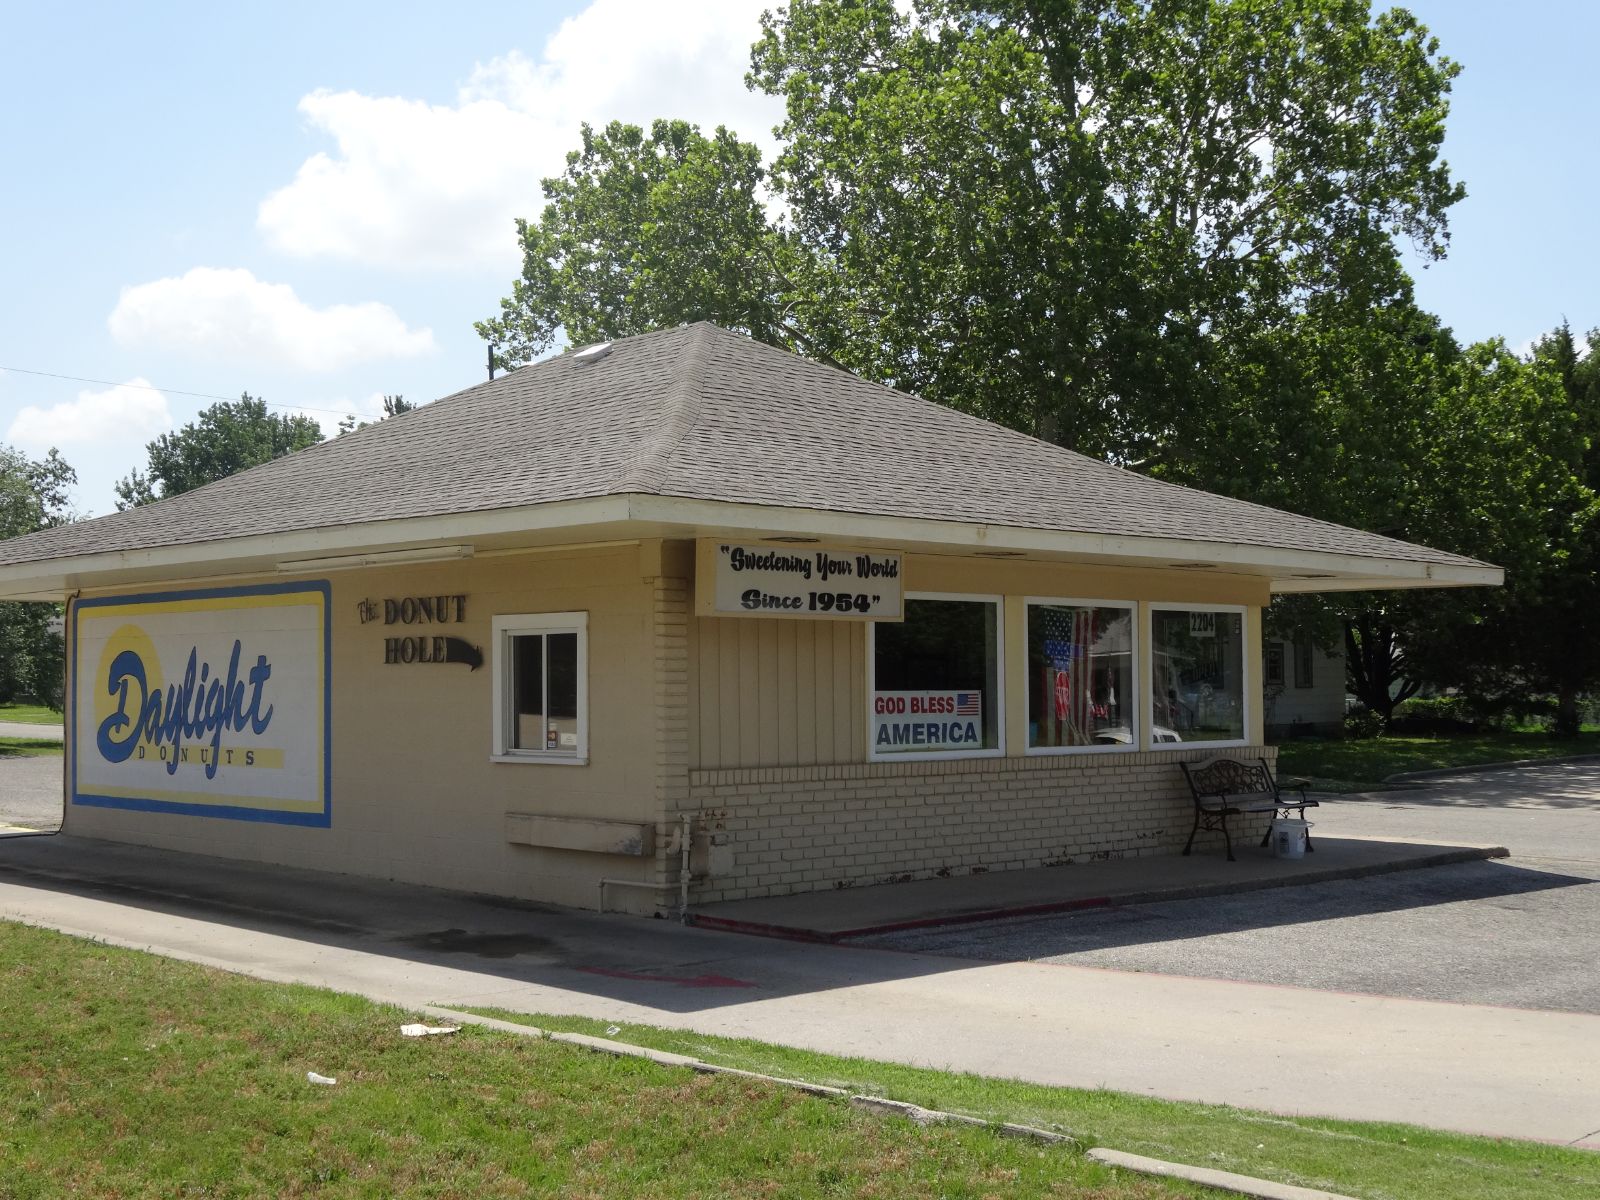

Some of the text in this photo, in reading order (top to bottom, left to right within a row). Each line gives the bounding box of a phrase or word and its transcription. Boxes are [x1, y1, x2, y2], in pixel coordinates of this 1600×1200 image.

[816, 553, 853, 581] Your
[856, 555, 898, 579] World
[357, 595, 467, 625] The DONUT
[741, 589, 803, 610] Since
[1191, 613, 1215, 632] 2204
[384, 636, 445, 665] HOLE
[96, 639, 274, 780] Daylight
[875, 697, 954, 714] GOD BLESS
[877, 722, 978, 744] AMERICA
[138, 745, 255, 766] DONUTS
